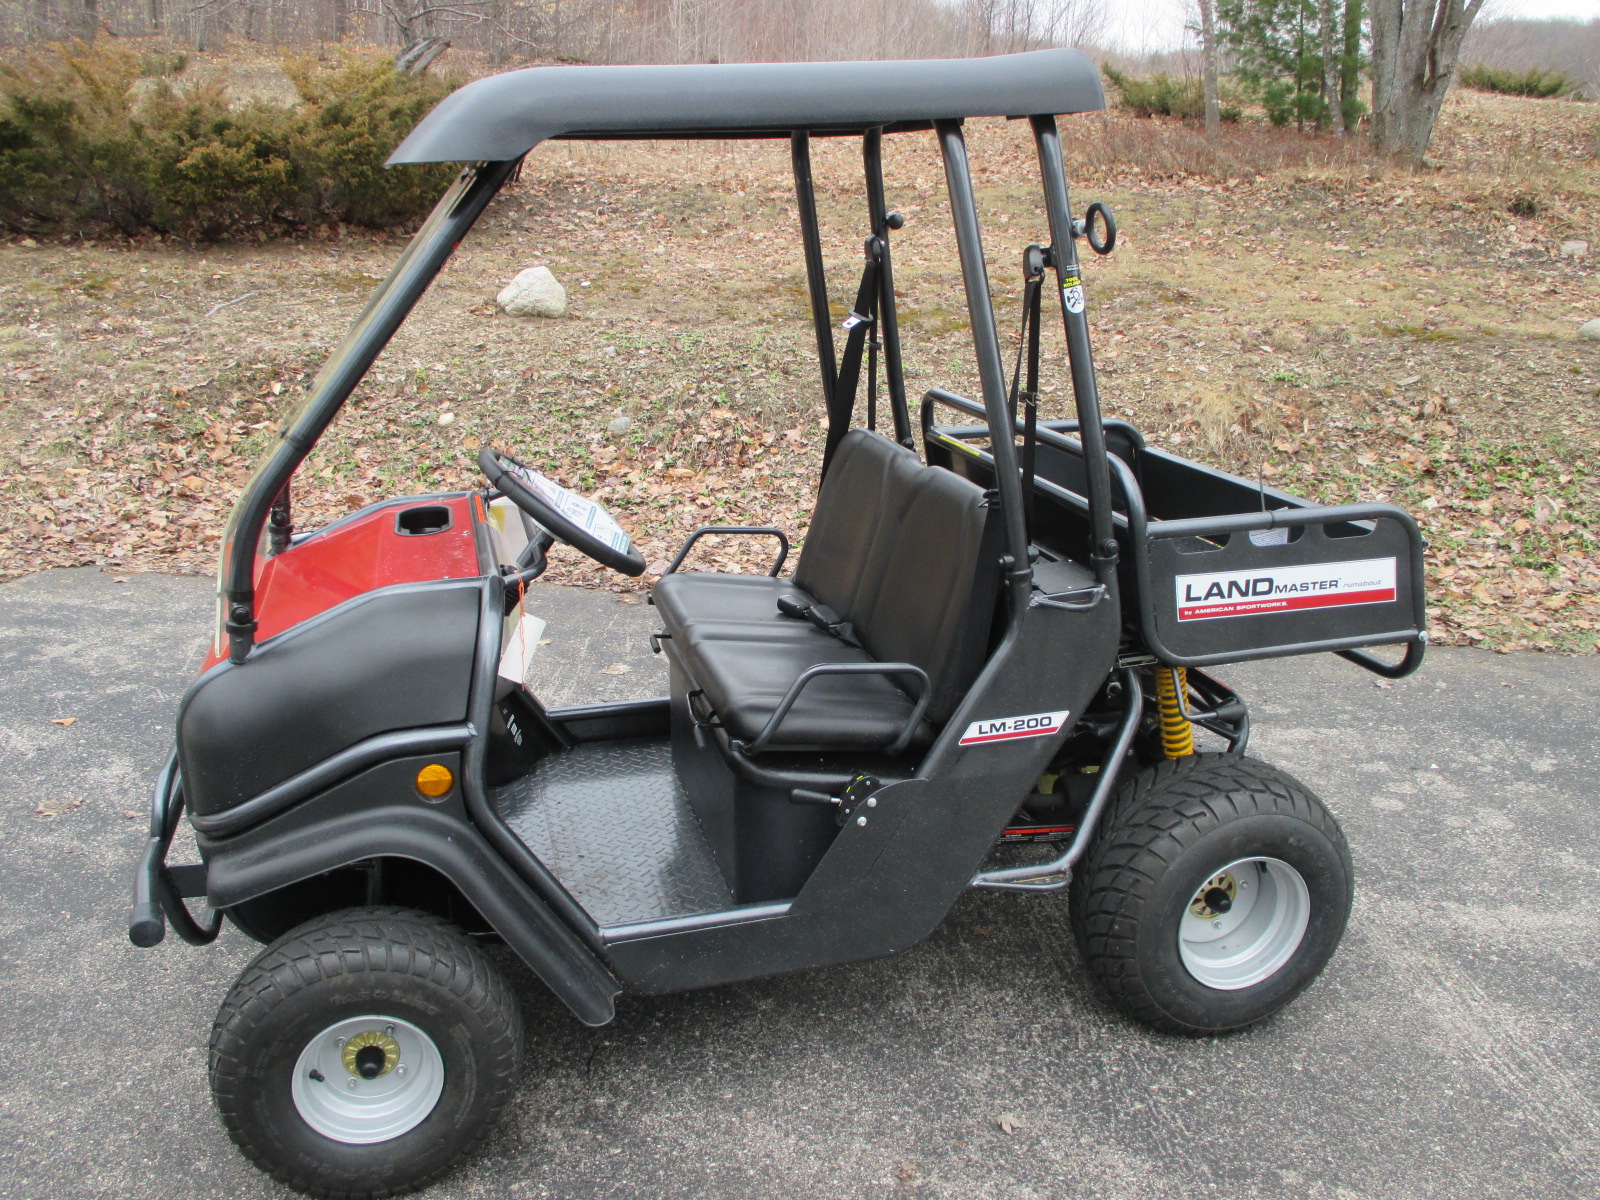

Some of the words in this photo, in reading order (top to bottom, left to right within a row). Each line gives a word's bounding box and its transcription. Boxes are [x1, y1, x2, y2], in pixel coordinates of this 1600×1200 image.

[1343, 579, 1382, 588] runabout
[1195, 605, 1235, 614] AMERICAN
[978, 716, 1052, 735] LM-200
